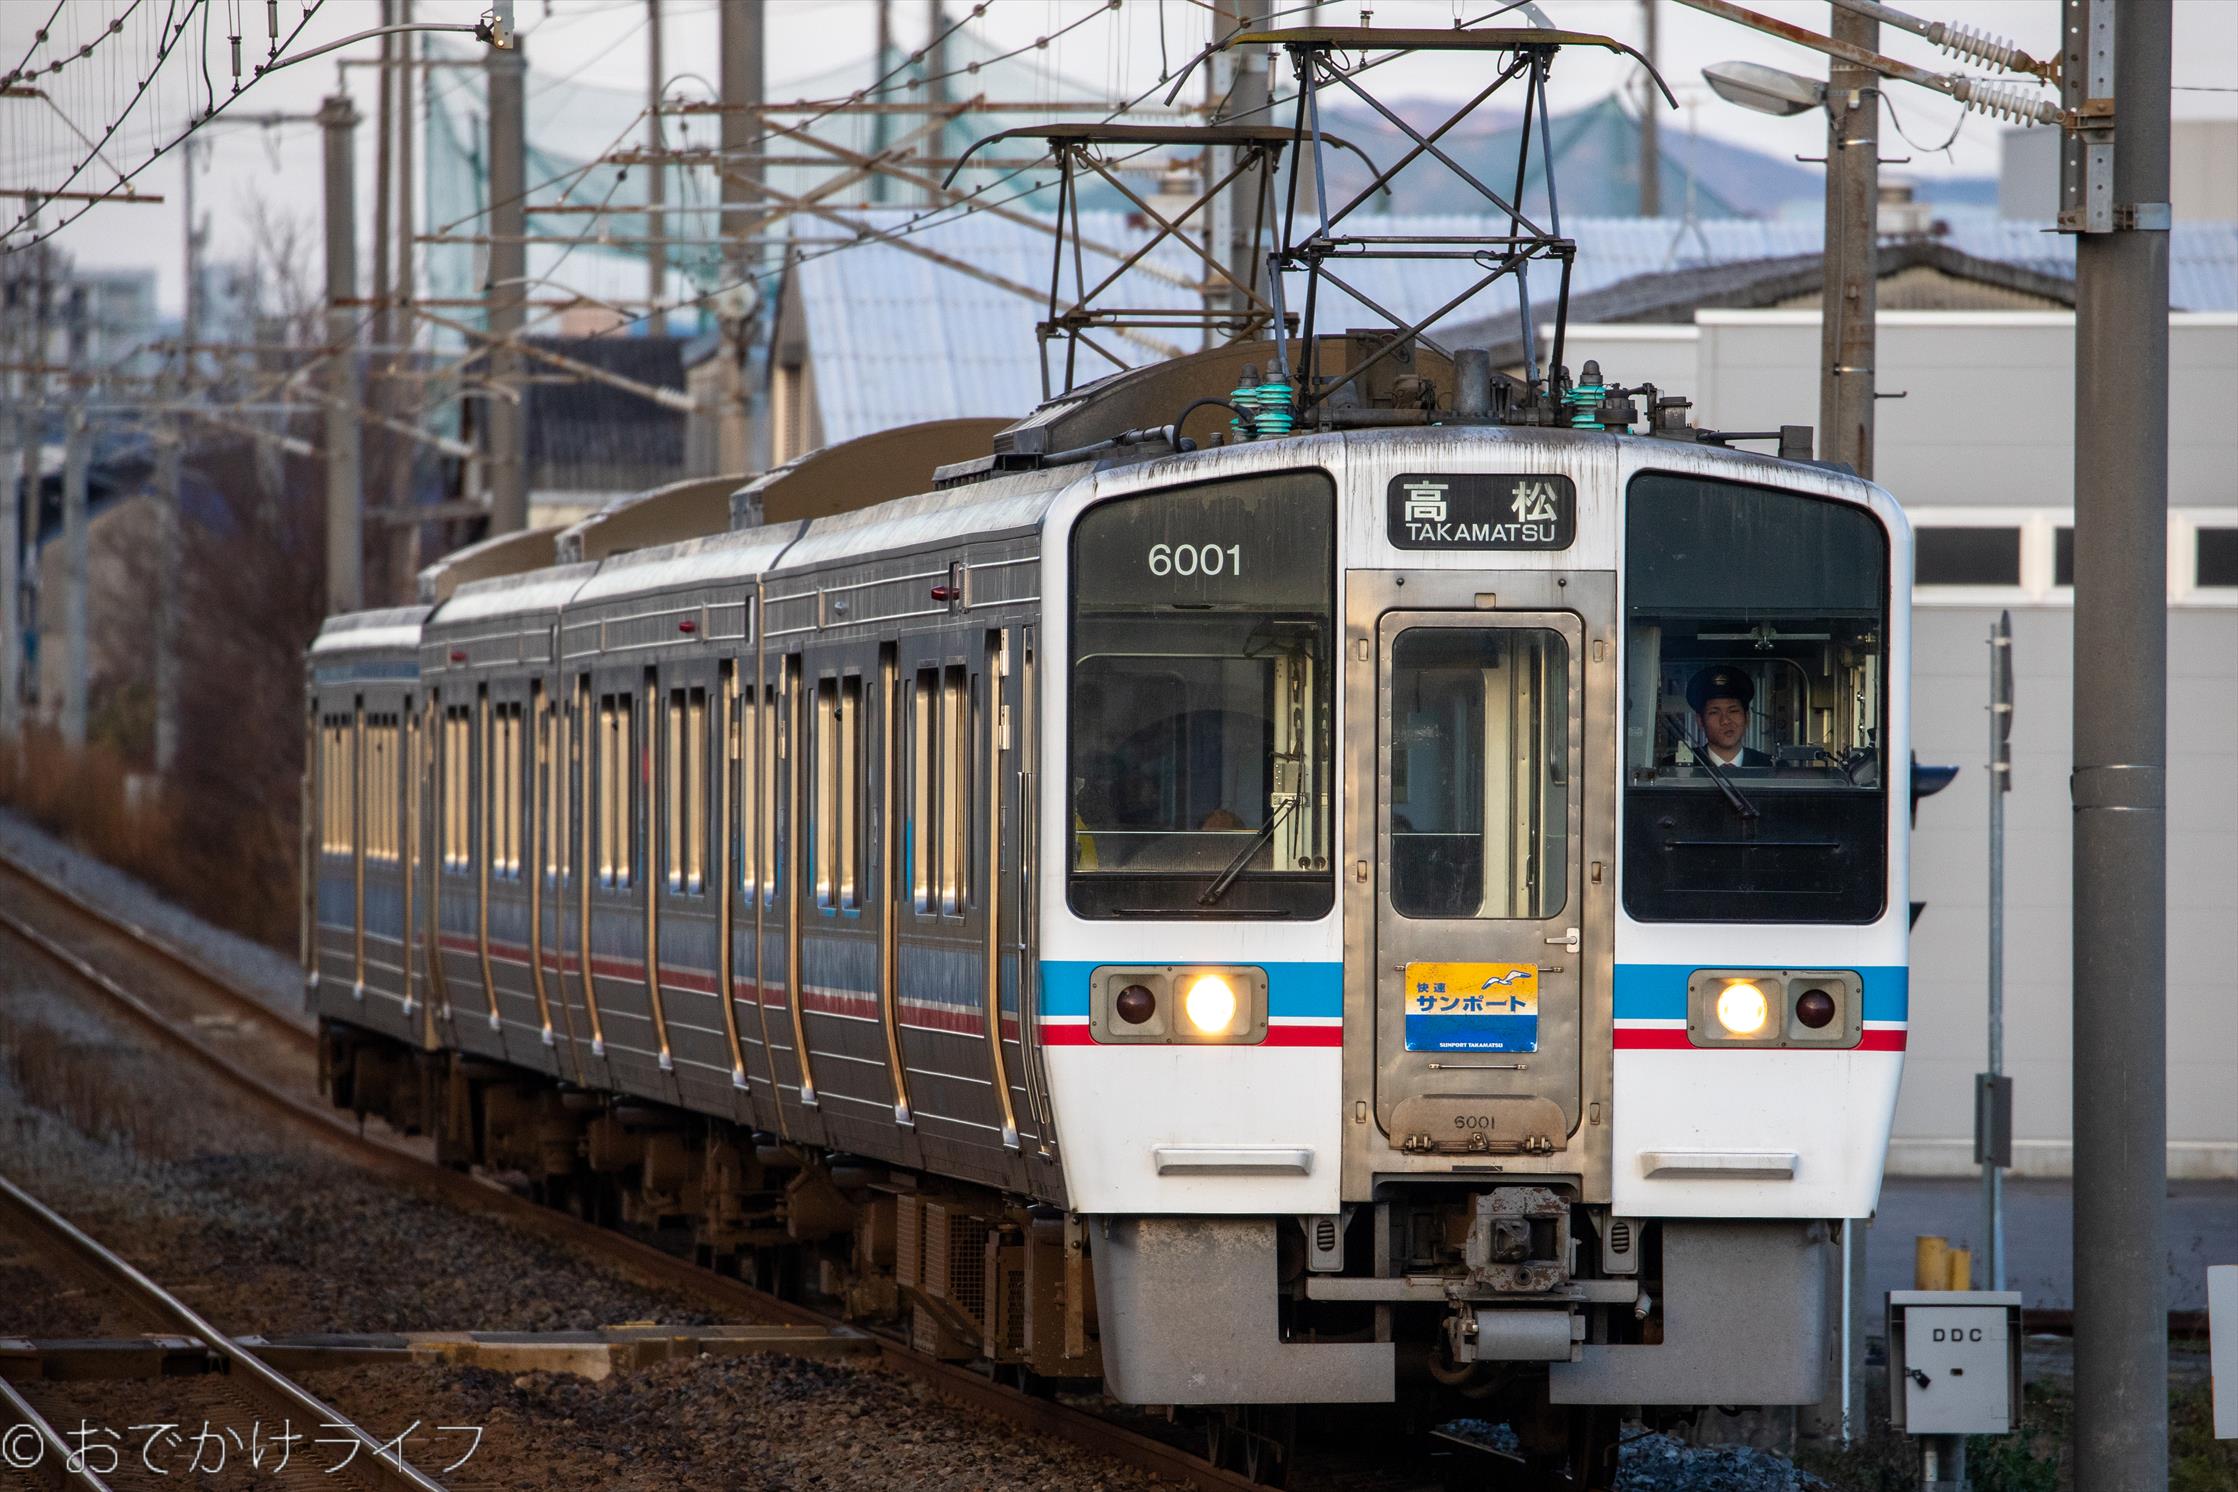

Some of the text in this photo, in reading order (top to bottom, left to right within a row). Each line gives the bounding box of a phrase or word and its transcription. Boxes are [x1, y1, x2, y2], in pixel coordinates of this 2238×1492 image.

[1403, 480, 1558, 523] 高松
[1406, 523, 1555, 542] TAKAMATSU
[1148, 543, 1240, 576] 6001
[1416, 982, 1446, 993] 快速
[1416, 995, 1526, 1012] サンポート
[1454, 1115, 1495, 1129] 6001
[1932, 1328, 1982, 1342] DDC
